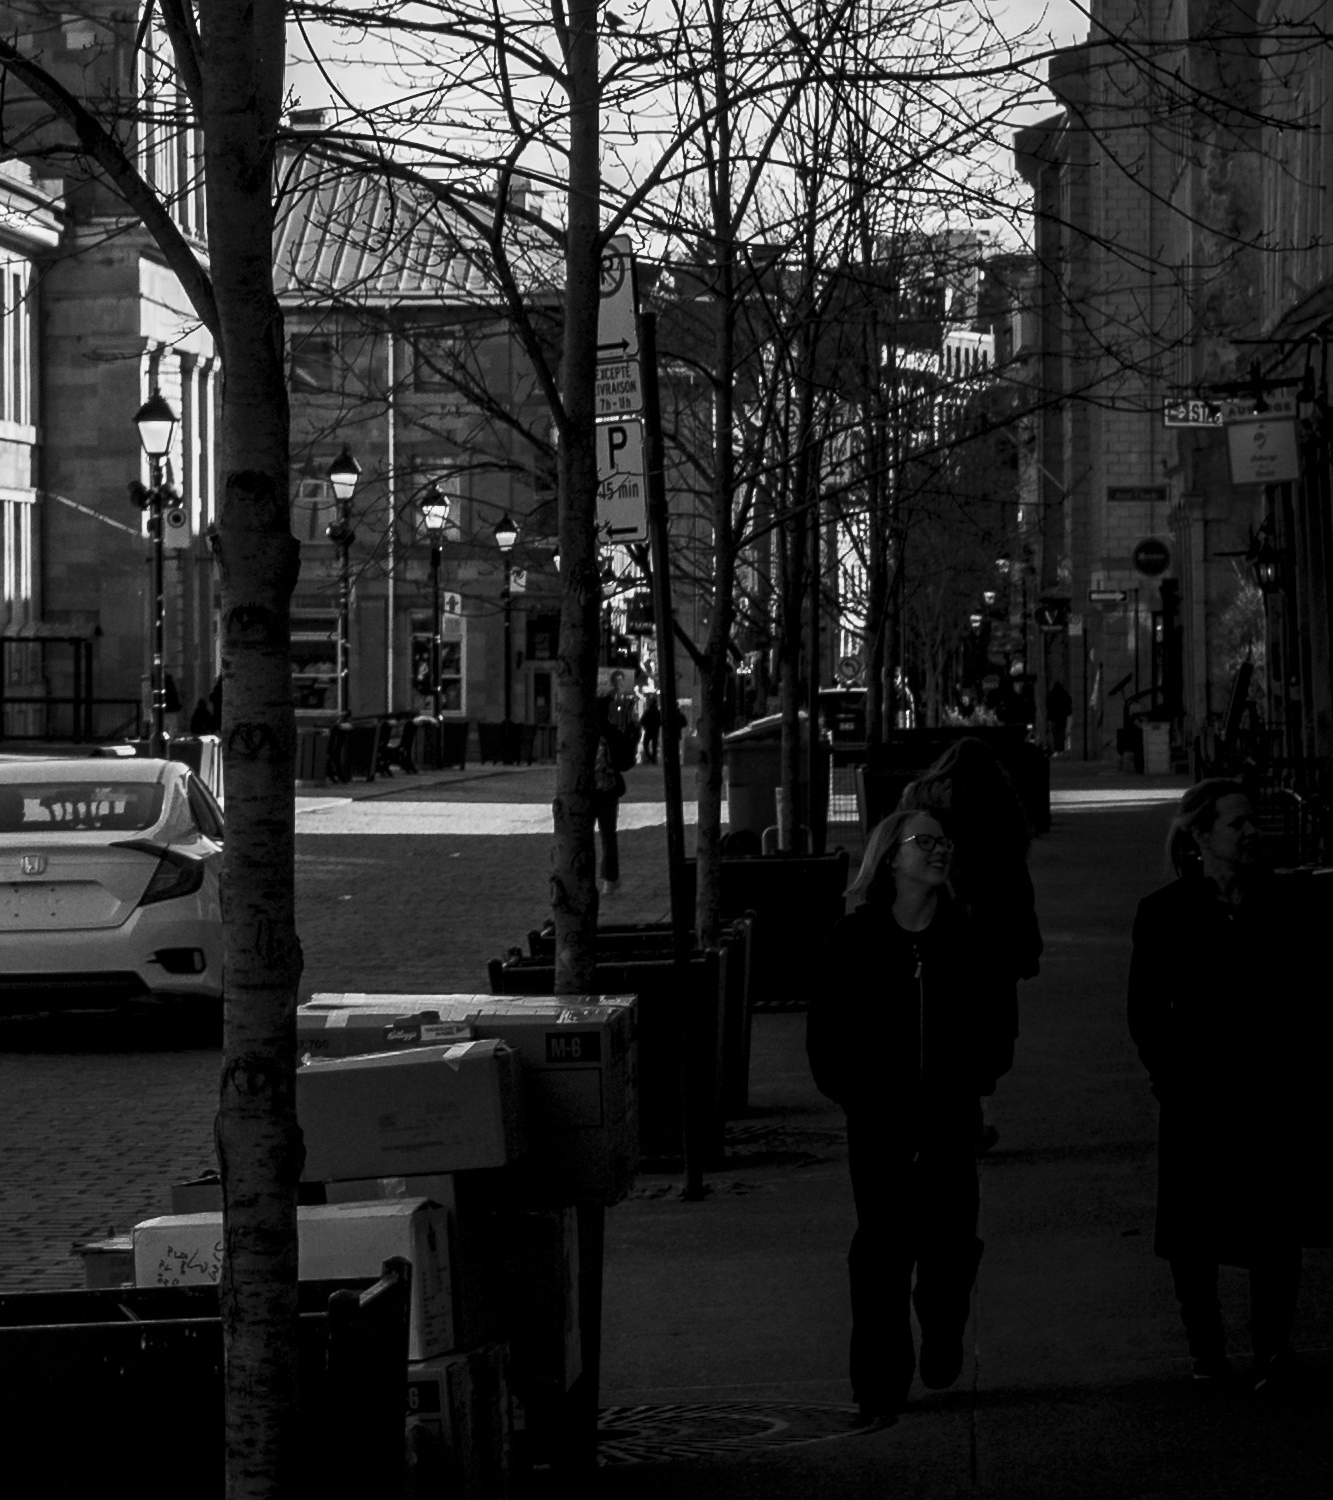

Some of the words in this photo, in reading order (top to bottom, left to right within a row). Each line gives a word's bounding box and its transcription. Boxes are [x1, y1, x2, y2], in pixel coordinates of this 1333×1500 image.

[595, 380, 637, 396] IVRAISON
[608, 426, 627, 469] P
[618, 480, 639, 499] min
